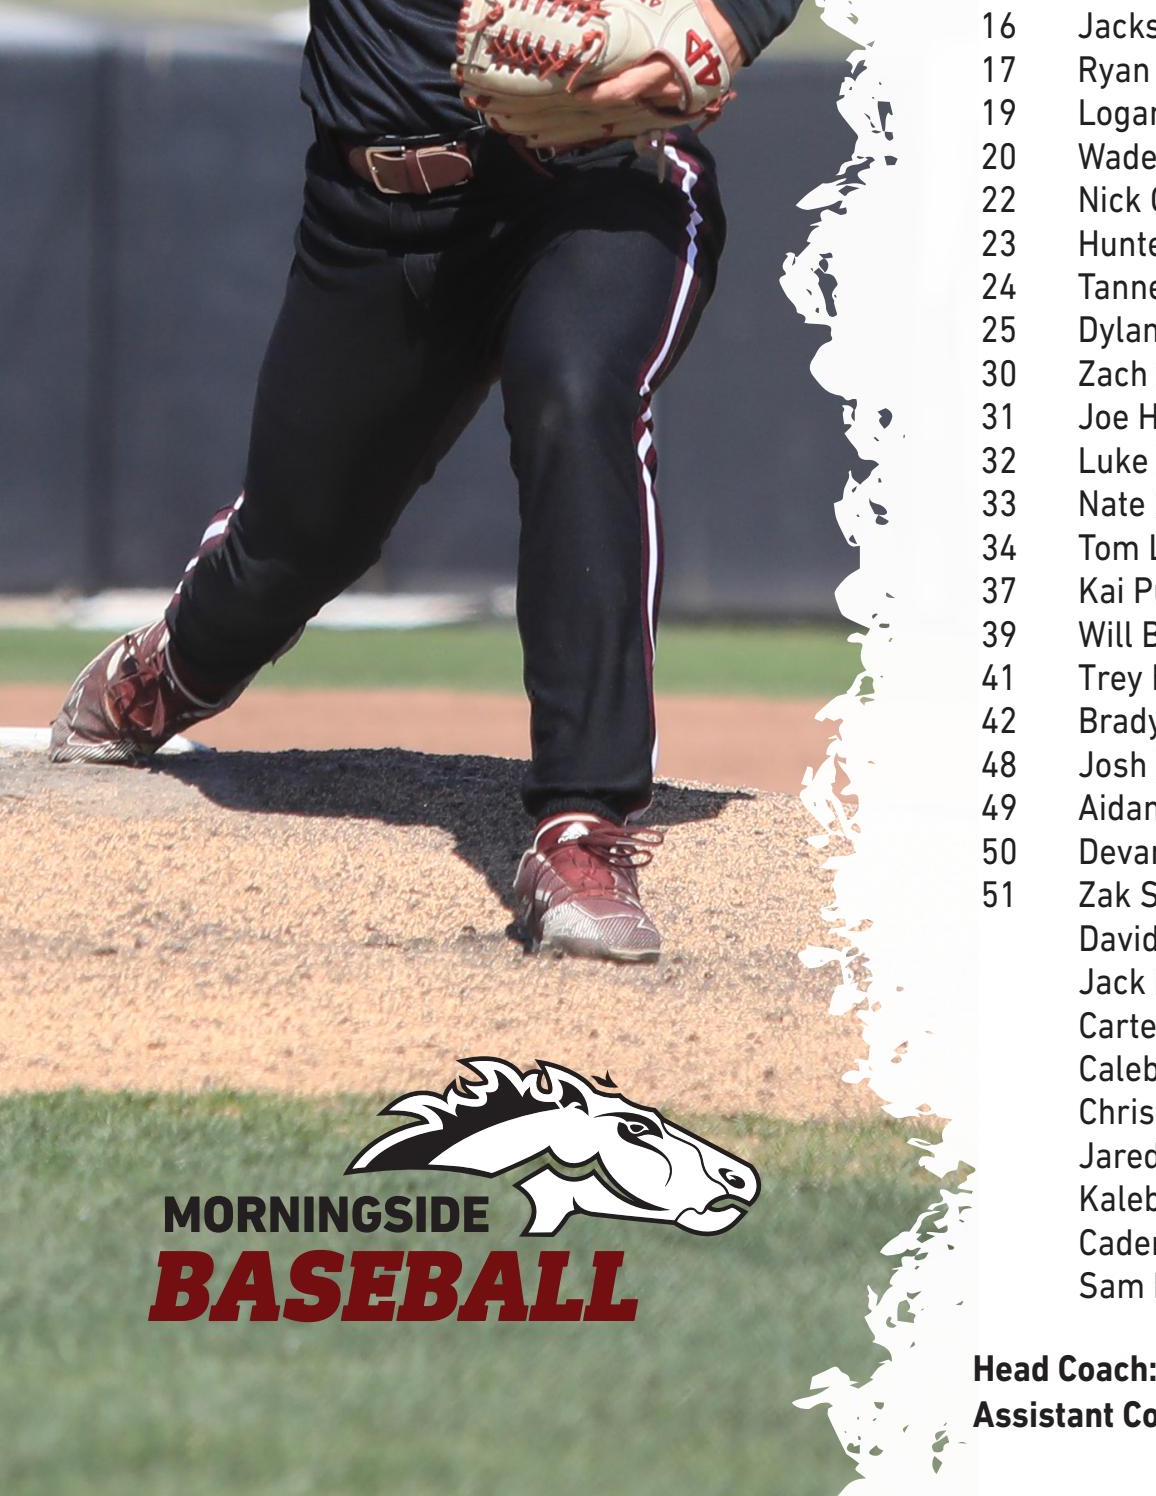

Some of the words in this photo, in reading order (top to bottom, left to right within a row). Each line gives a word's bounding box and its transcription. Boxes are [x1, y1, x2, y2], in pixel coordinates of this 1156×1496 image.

[983, 11, 1016, 39] 16
[685, 28, 721, 86] 44
[982, 142, 1016, 170] 20
[1078, 142, 1156, 171] Wade
[982, 272, 1017, 300] 24
[982, 359, 1016, 388] 30
[1078, 359, 1147, 387] Zach
[982, 533, 1017, 561] 34
[1078, 533, 1139, 561] Tom
[981, 663, 1011, 691] 41
[1078, 663, 1143, 698] Trey
[981, 793, 1017, 821] 49
[983, 880, 1012, 908] 51
[1079, 880, 1131, 909] Zak
[1078, 967, 1146, 995] Jack
[1079, 1097, 1154, 1125] Chris
[164, 1195, 489, 1233] MORNINGSIDE
[148, 1249, 638, 1323] BASEBALL
[1079, 1271, 1144, 1299] Sam
[974, 1354, 1049, 1382] Head
[1058, 1354, 1156, 1383] Coach:
[972, 1400, 1114, 1428] Assistant
